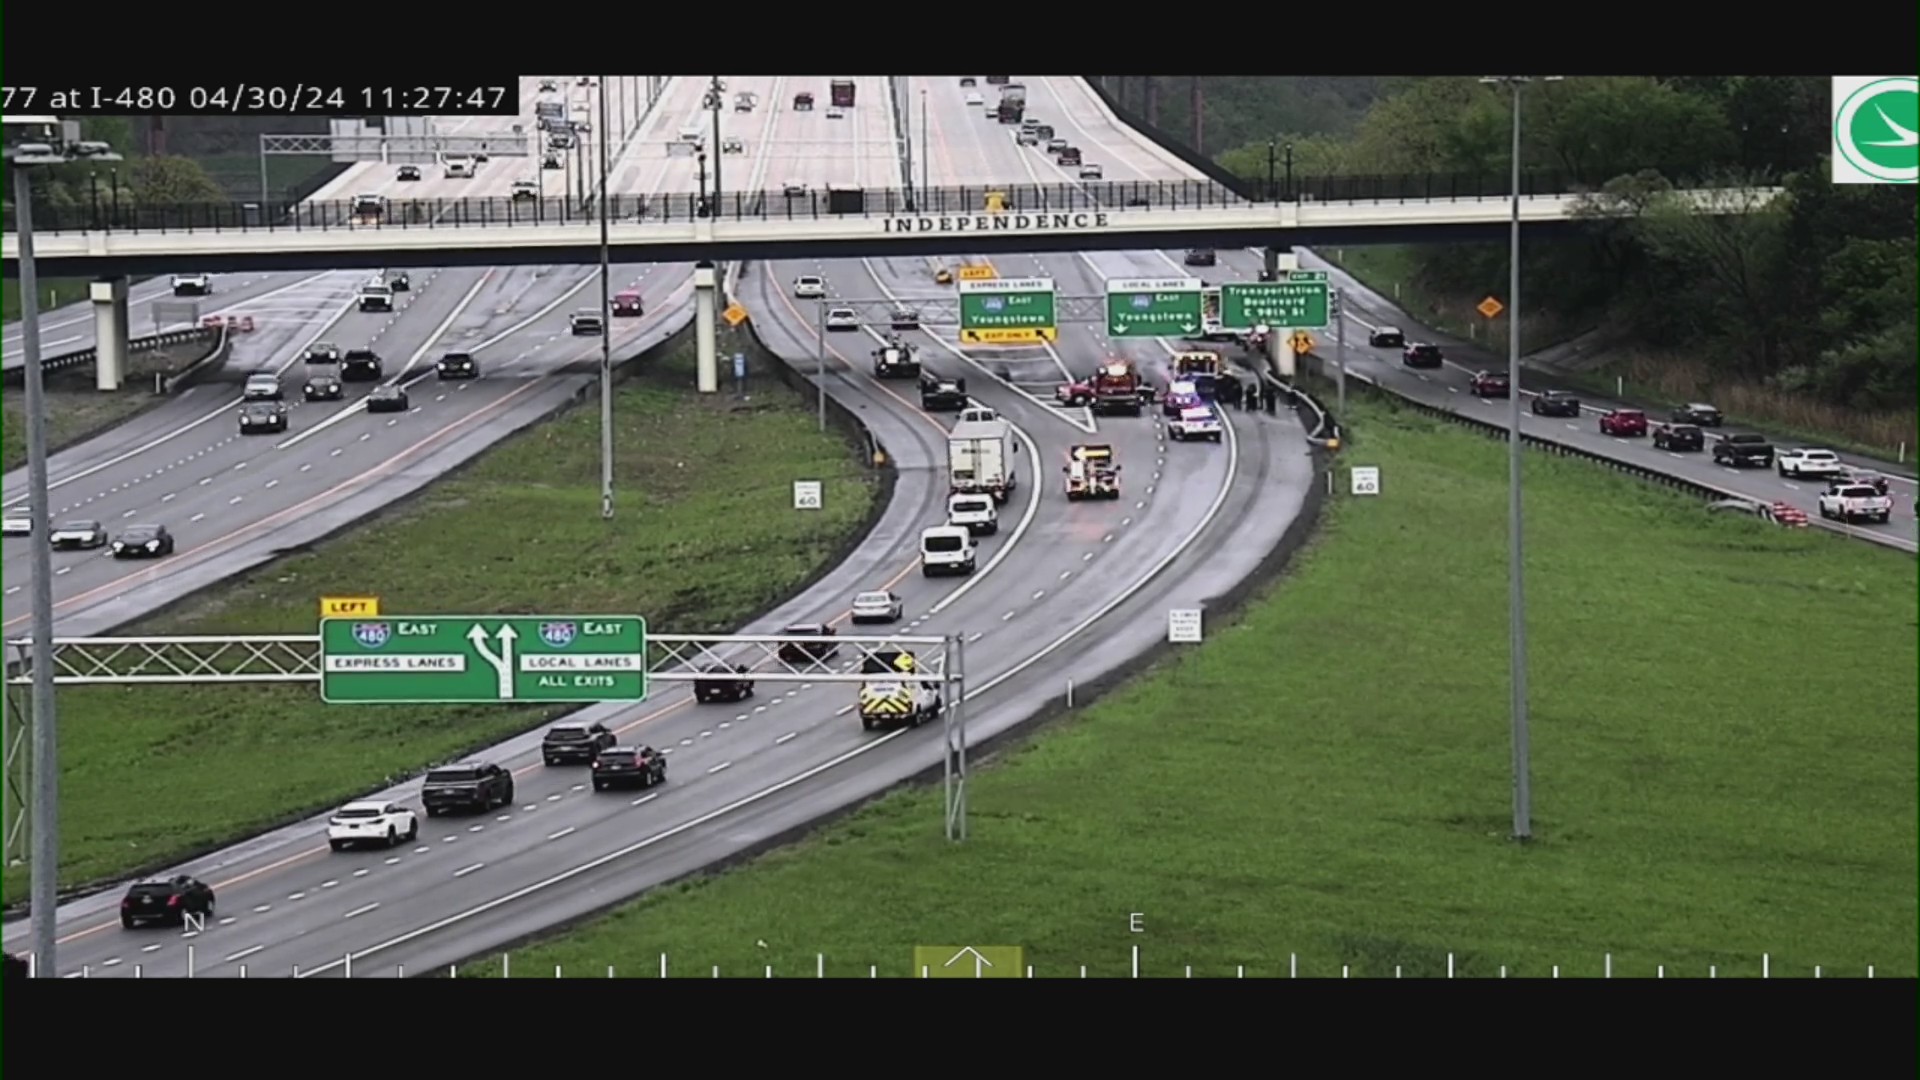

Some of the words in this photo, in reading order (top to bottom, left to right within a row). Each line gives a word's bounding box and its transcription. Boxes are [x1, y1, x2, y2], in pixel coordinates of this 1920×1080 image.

[884, 213, 1108, 232] INDEPENDENCE
[1229, 287, 1321, 296] Transportation
[1243, 297, 1306, 306] Boulevard
[1292, 308, 1305, 316] St
[971, 315, 1046, 325] Youngstown
[1118, 312, 1193, 323] Youngstown
[331, 602, 367, 612] LEFT
[359, 631, 386, 642] 480
[545, 631, 571, 641] 480
[335, 658, 400, 668] EXPRESS
[408, 658, 456, 667] LANES
[529, 658, 576, 667] LOCAL
[585, 658, 632, 667] LANES
[538, 676, 566, 686] ALL
[574, 676, 614, 686] EXITS
